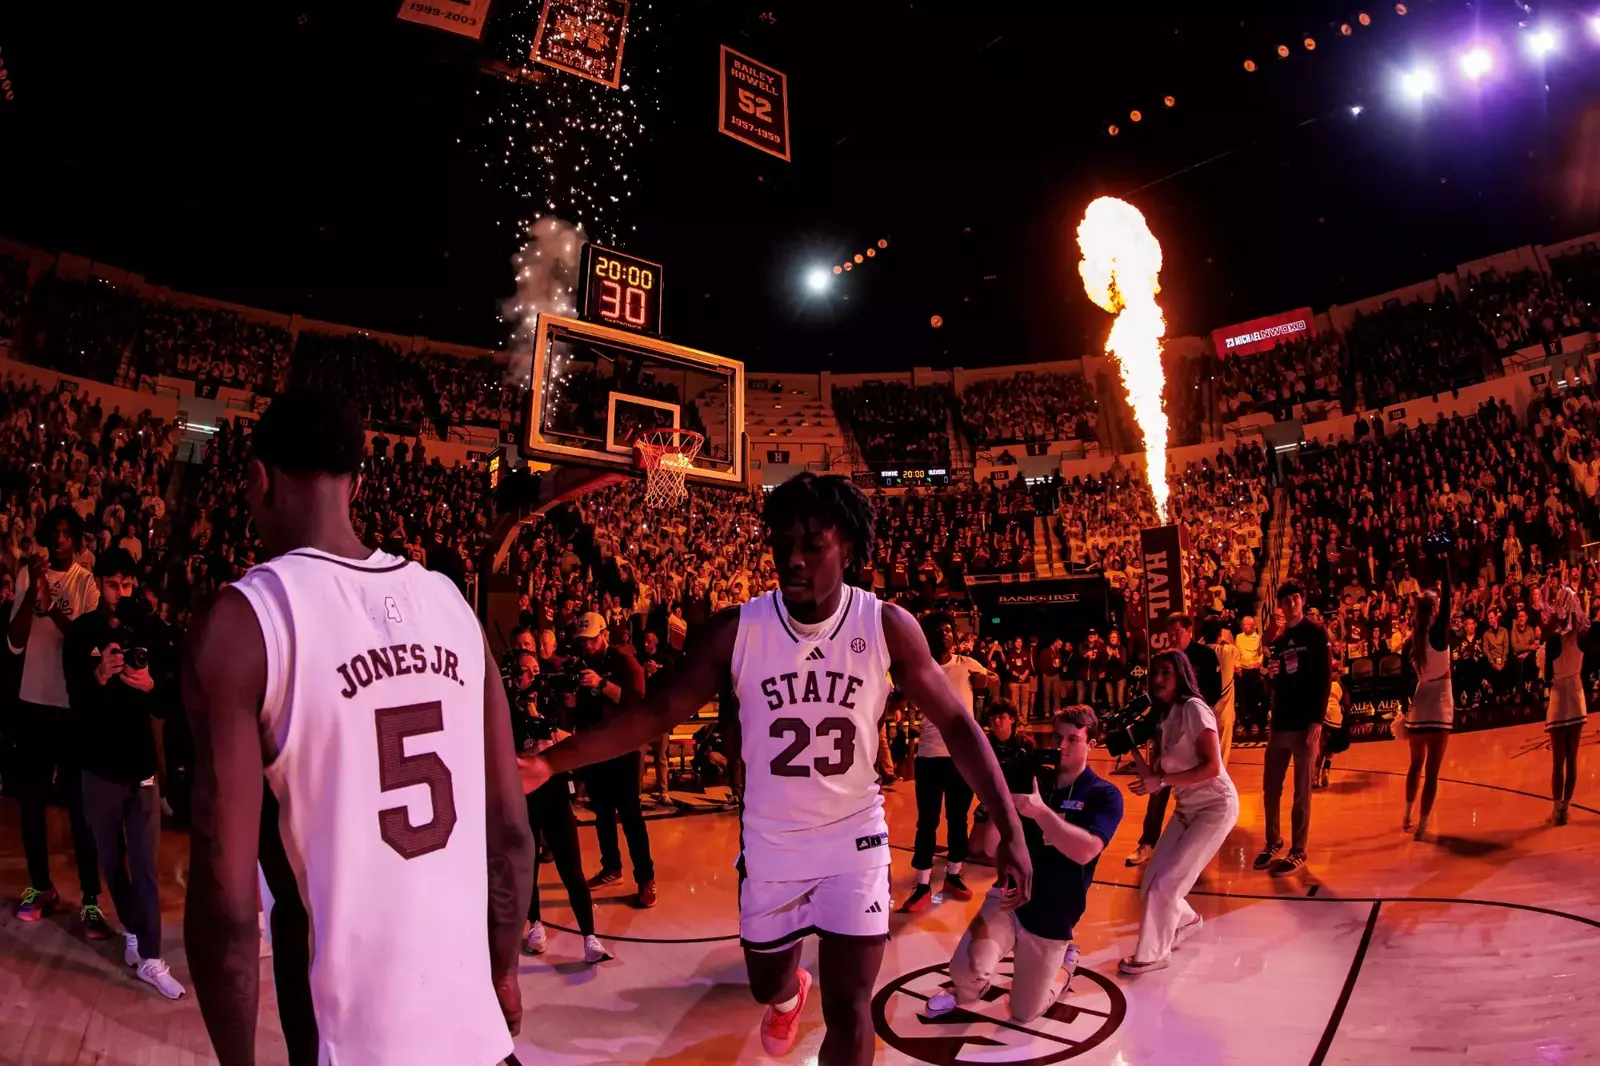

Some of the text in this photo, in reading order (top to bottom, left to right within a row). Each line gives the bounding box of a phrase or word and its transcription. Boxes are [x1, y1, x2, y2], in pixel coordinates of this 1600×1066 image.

[409, 3, 477, 26] 1999-2003
[731, 68, 779, 96] HOWELL
[734, 60, 774, 84] BAILEY
[739, 88, 772, 123] 52
[731, 116, 780, 143] 1957-1959
[596, 256, 652, 290] 20:00
[601, 280, 646, 324] 30
[1225, 338, 1235, 348] 23
[774, 451, 783, 462] H
[903, 470, 925, 479] 20:00
[1145, 551, 1170, 619] HAIL
[335, 643, 465, 699] JONES JR.
[761, 671, 864, 711] STATE
[769, 717, 856, 777] 23
[374, 700, 457, 860] 5
